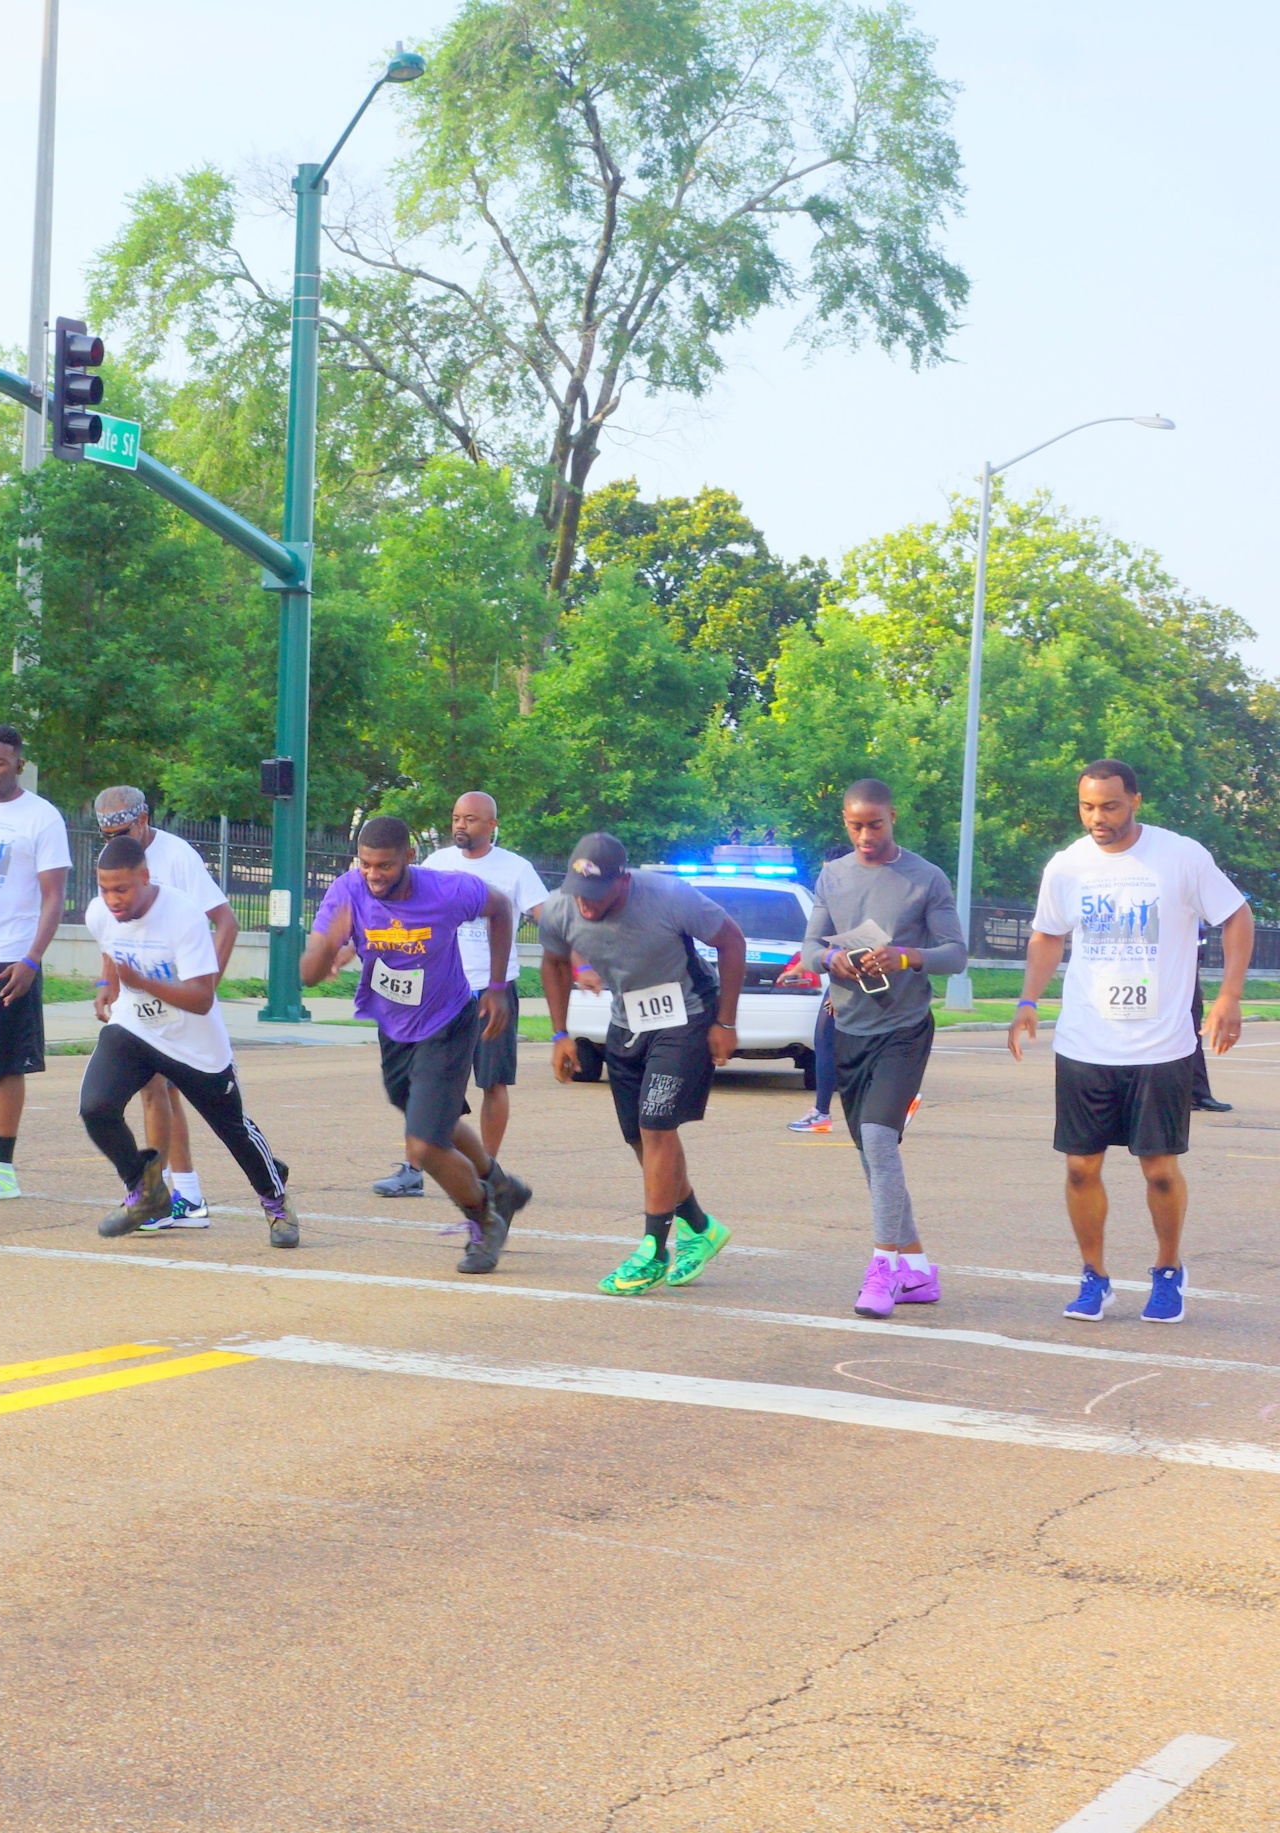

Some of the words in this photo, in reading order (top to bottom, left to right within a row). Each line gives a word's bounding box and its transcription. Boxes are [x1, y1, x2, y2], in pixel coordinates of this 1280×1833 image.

[121, 432, 135, 457] St
[1081, 893, 1114, 915] 5K
[366, 940, 427, 955] OMEGA
[1111, 946, 1121, 956] 2,
[1126, 945, 1157, 955] 2018
[114, 950, 142, 971] 5K
[379, 973, 413, 996] 263
[1108, 985, 1147, 1006] 228
[133, 999, 167, 1018] 262
[637, 995, 673, 1018] 109
